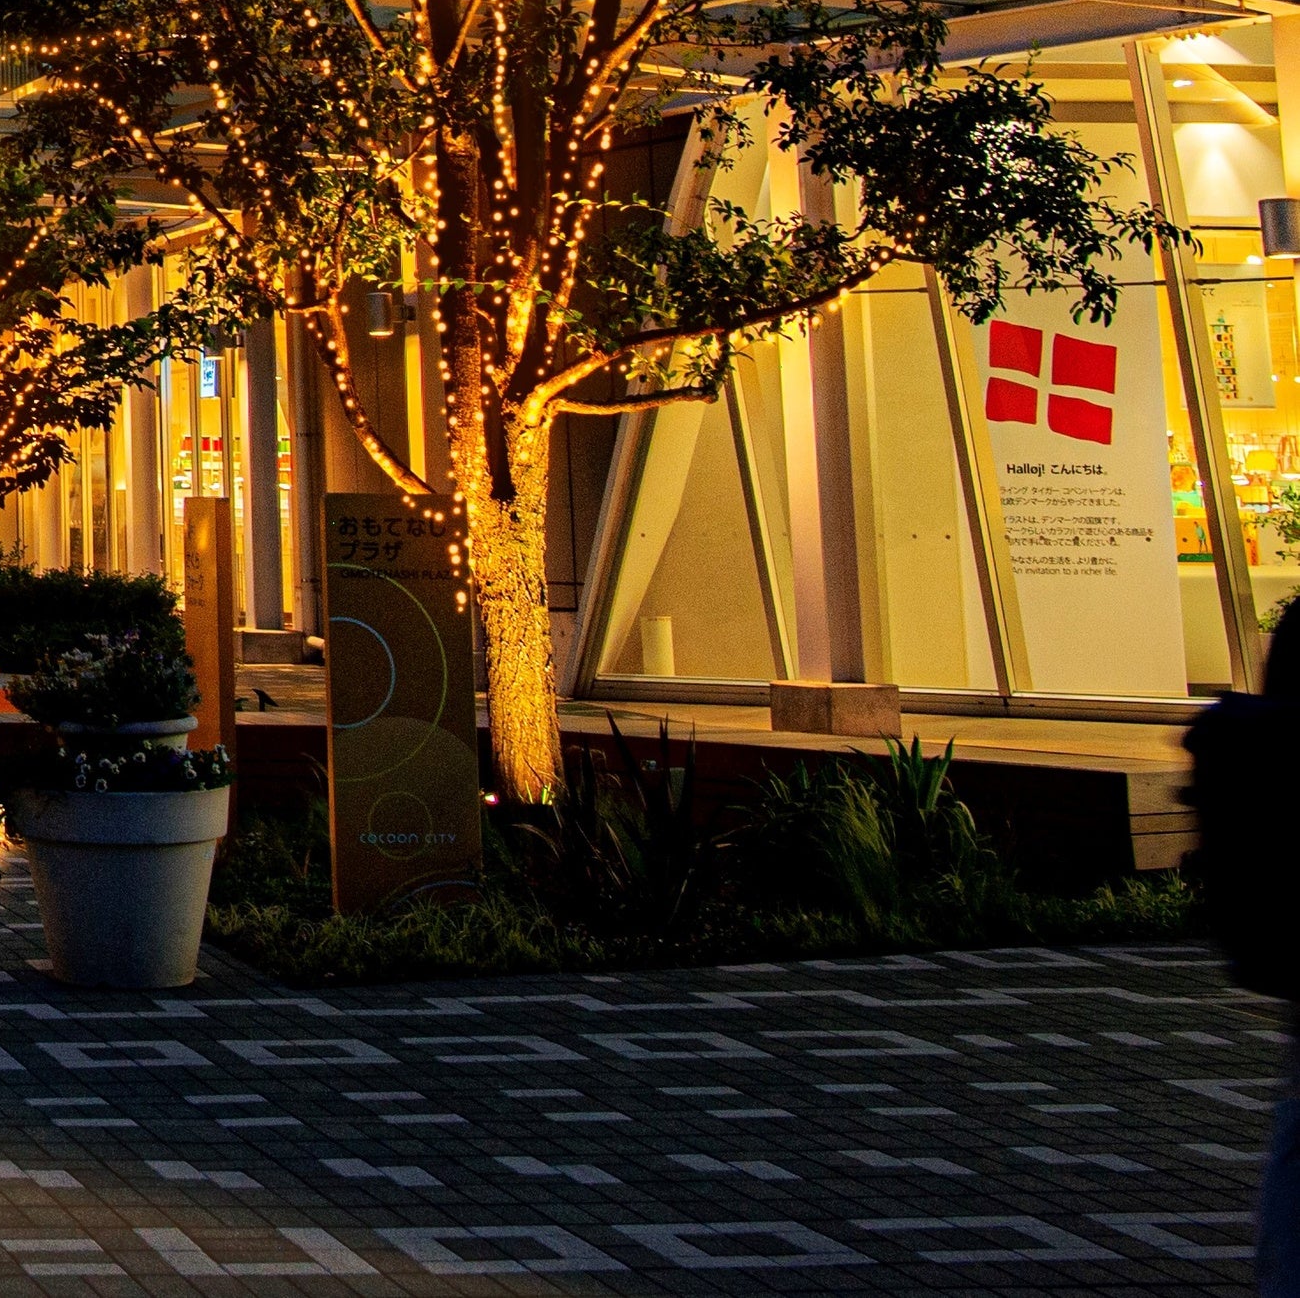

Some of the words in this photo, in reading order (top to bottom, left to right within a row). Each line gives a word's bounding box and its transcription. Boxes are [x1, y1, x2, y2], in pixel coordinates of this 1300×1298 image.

[1006, 463, 1045, 477] Halløj!
[338, 515, 447, 538] おもてなし
[339, 539, 404, 562] プラザ
[422, 569, 453, 580] PLAZ
